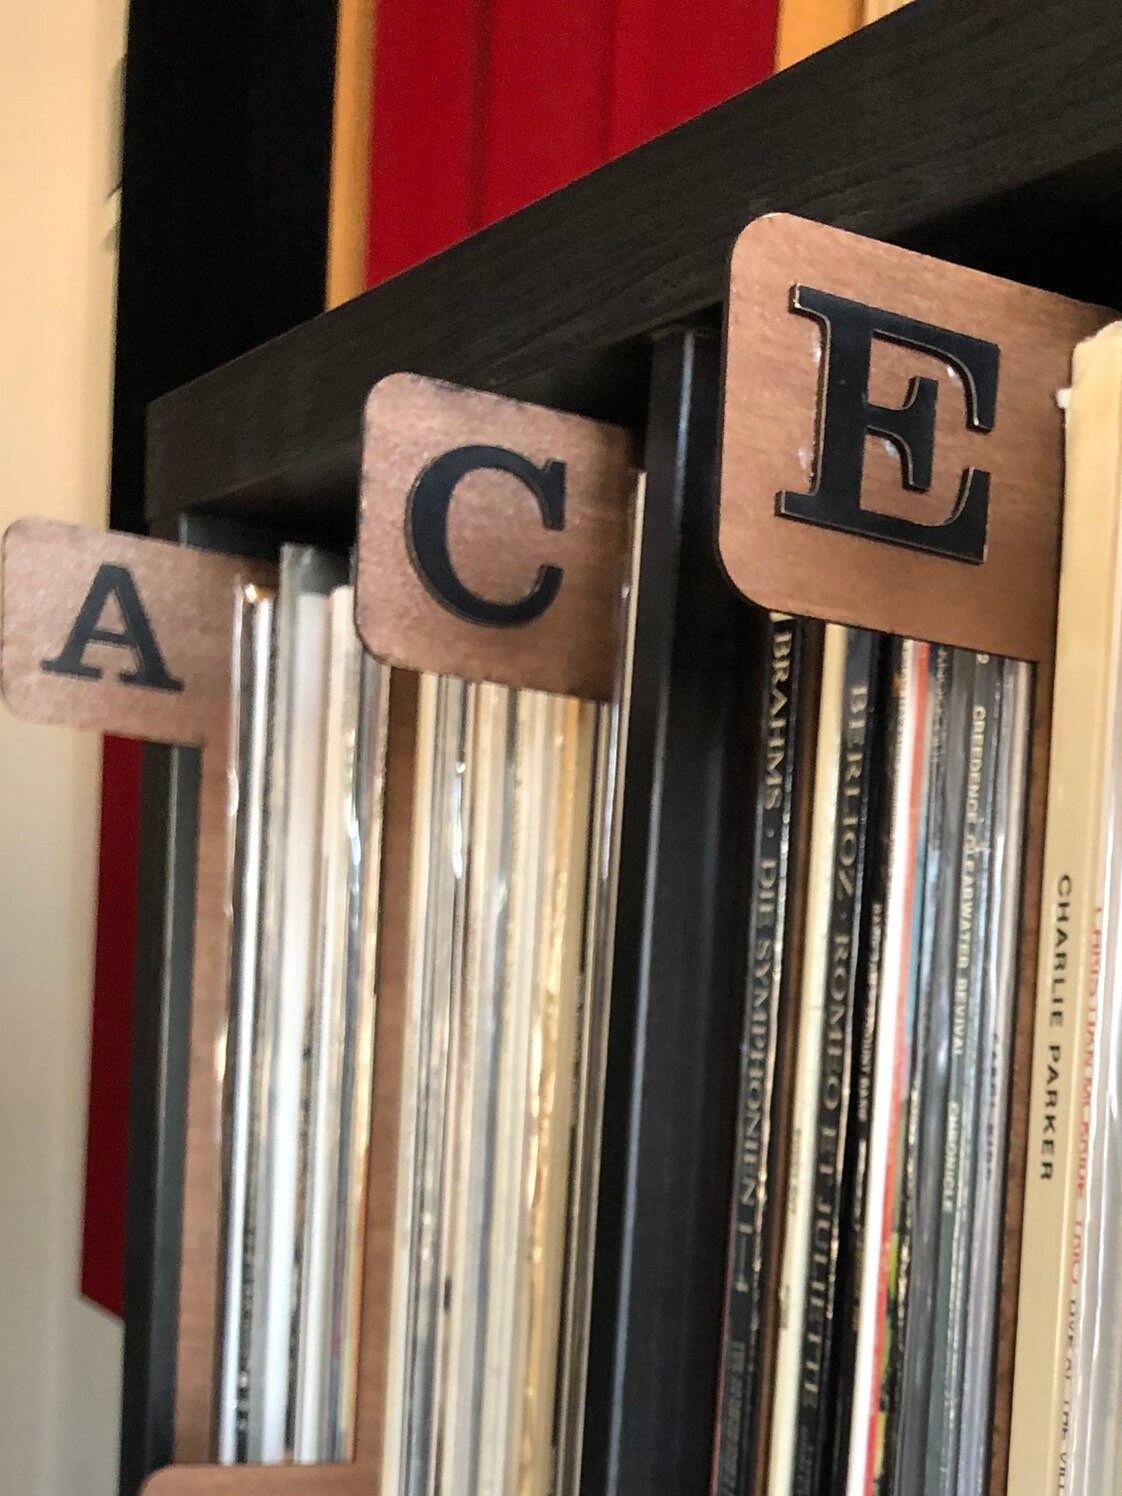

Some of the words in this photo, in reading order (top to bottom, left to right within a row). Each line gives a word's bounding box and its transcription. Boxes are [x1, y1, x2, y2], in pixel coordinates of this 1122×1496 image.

[775, 285, 999, 564] E
[402, 444, 567, 629] C
[40, 565, 185, 693] A
[762, 632, 791, 811] BRAHMS
[836, 685, 867, 901] BERLIOZ
[965, 705, 985, 824] CREEDENCE
[756, 856, 778, 928] DIE
[1048, 874, 1072, 1028] CHARLIE
[739, 937, 772, 1206] SYMPHONIEN
[821, 934, 850, 1110] ROMEO
[817, 1125, 835, 1177] ET
[941, 1101, 961, 1214] CHRONICLE
[1038, 1043, 1061, 1182] PARKER
[801, 1195, 831, 1409] JULIETTE
